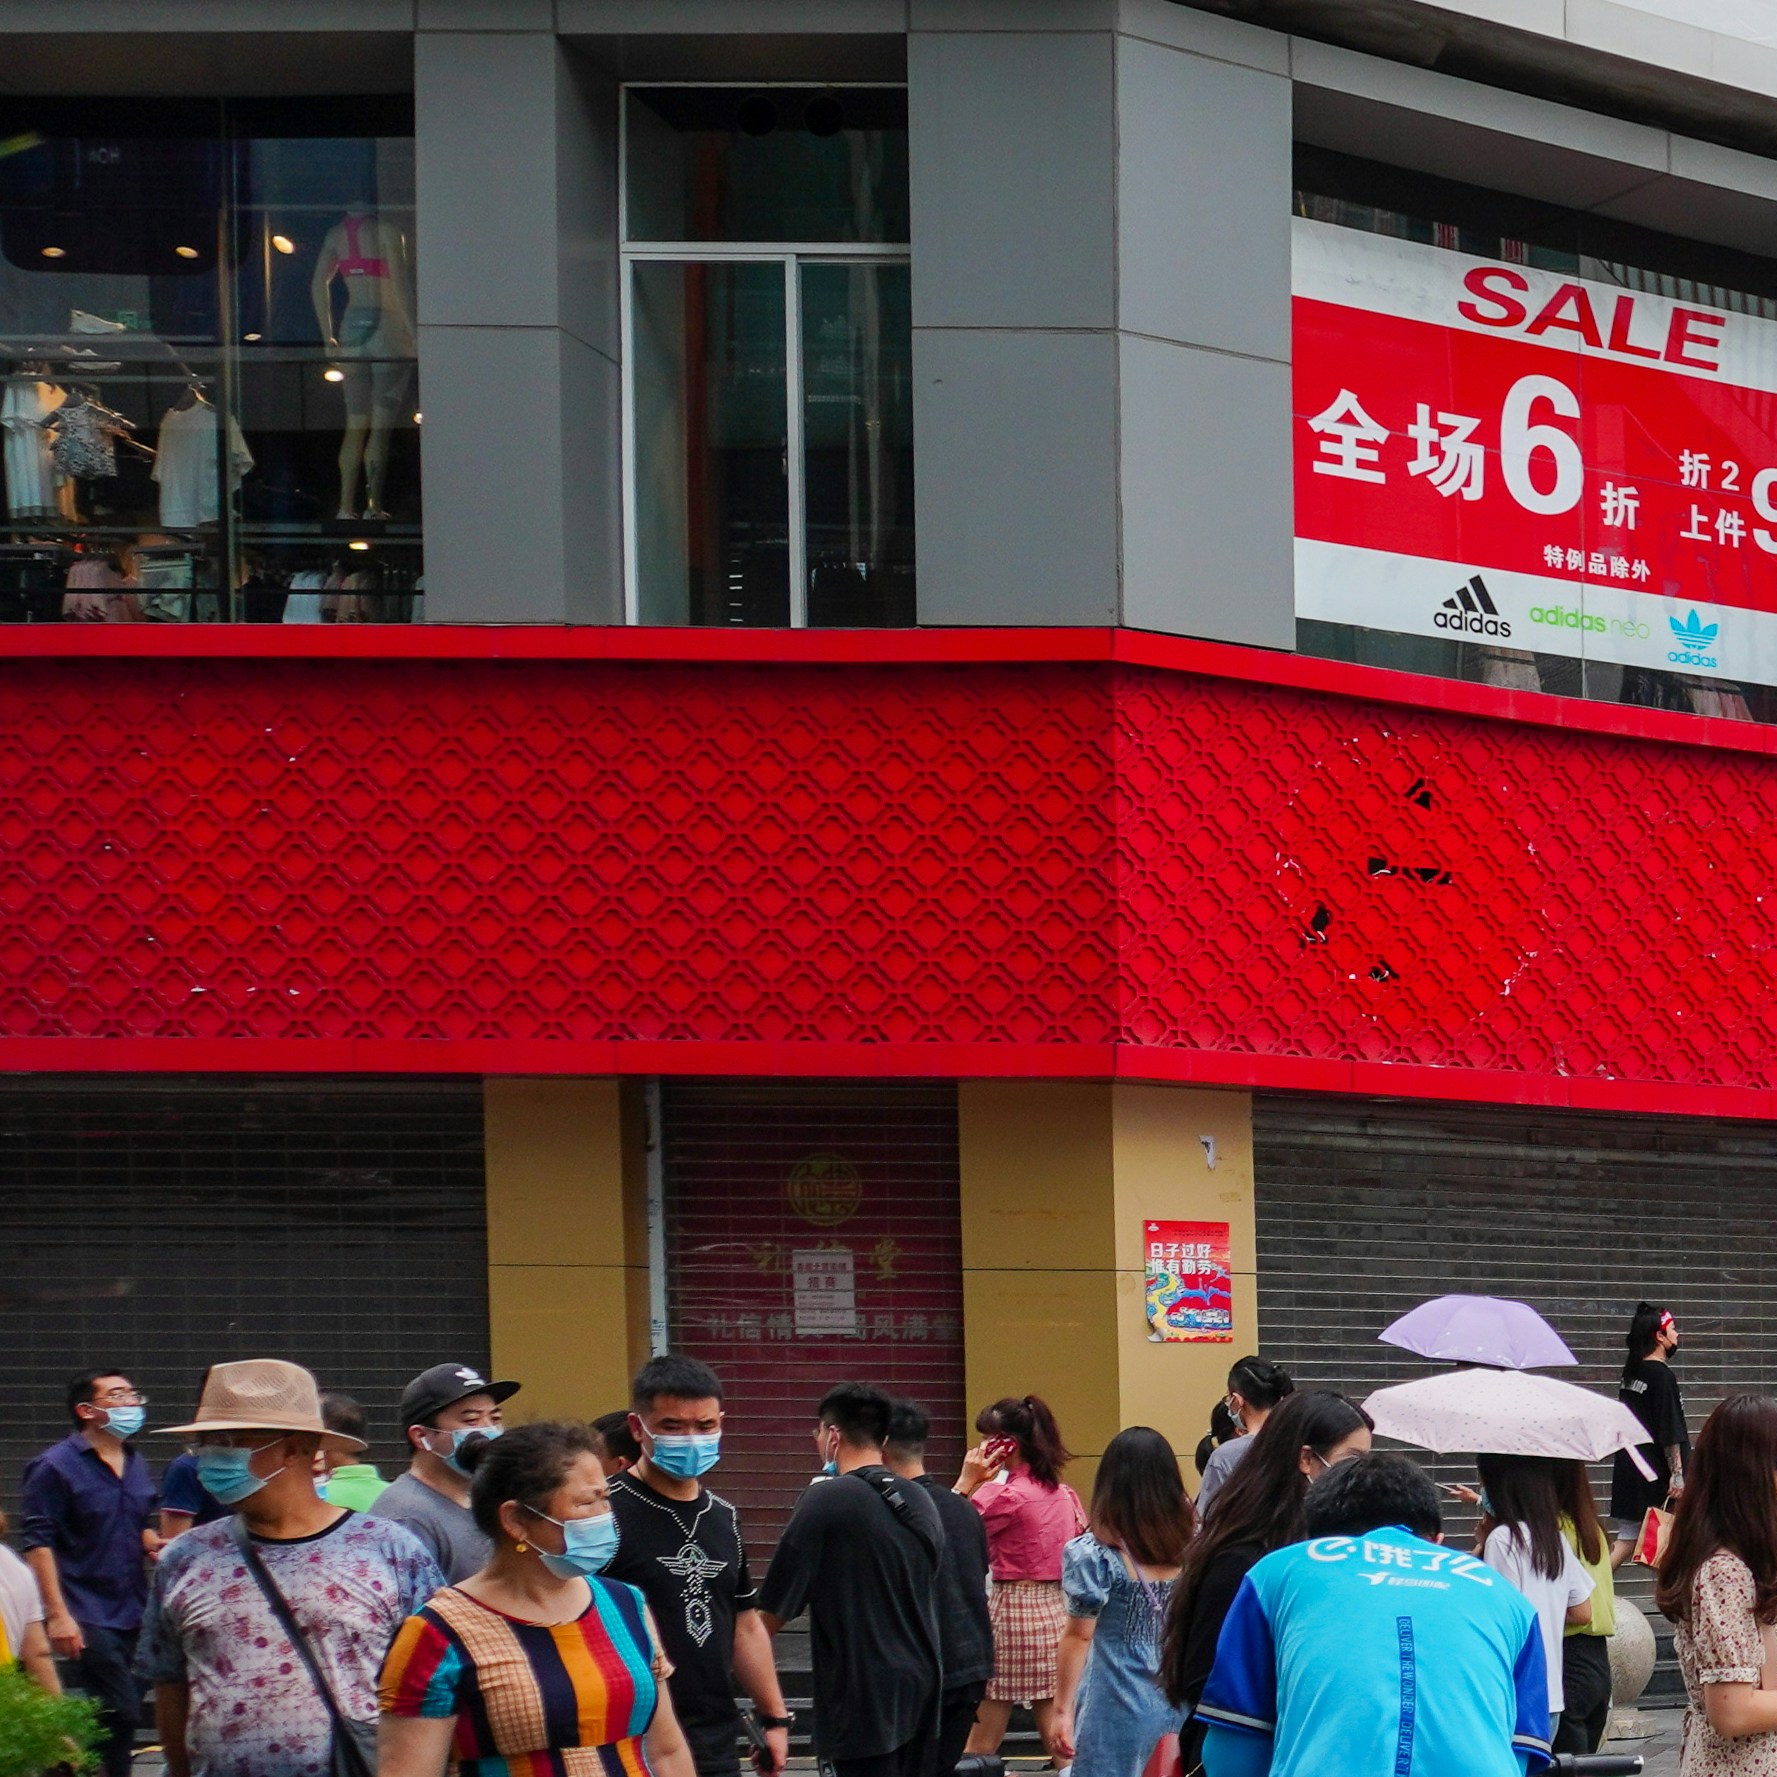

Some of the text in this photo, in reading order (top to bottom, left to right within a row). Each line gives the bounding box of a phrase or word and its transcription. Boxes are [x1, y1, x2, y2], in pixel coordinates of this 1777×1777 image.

[1457, 266, 1727, 373] SALE
[1543, 544, 1652, 583] 特例品除外
[1433, 607, 1512, 639] adidas
[1529, 604, 1651, 640] adidas neo
[1666, 650, 1719, 669] adidas
[1150, 1242, 1211, 1259] 日子过好
[1362, 1539, 1494, 1587] 饿了么
